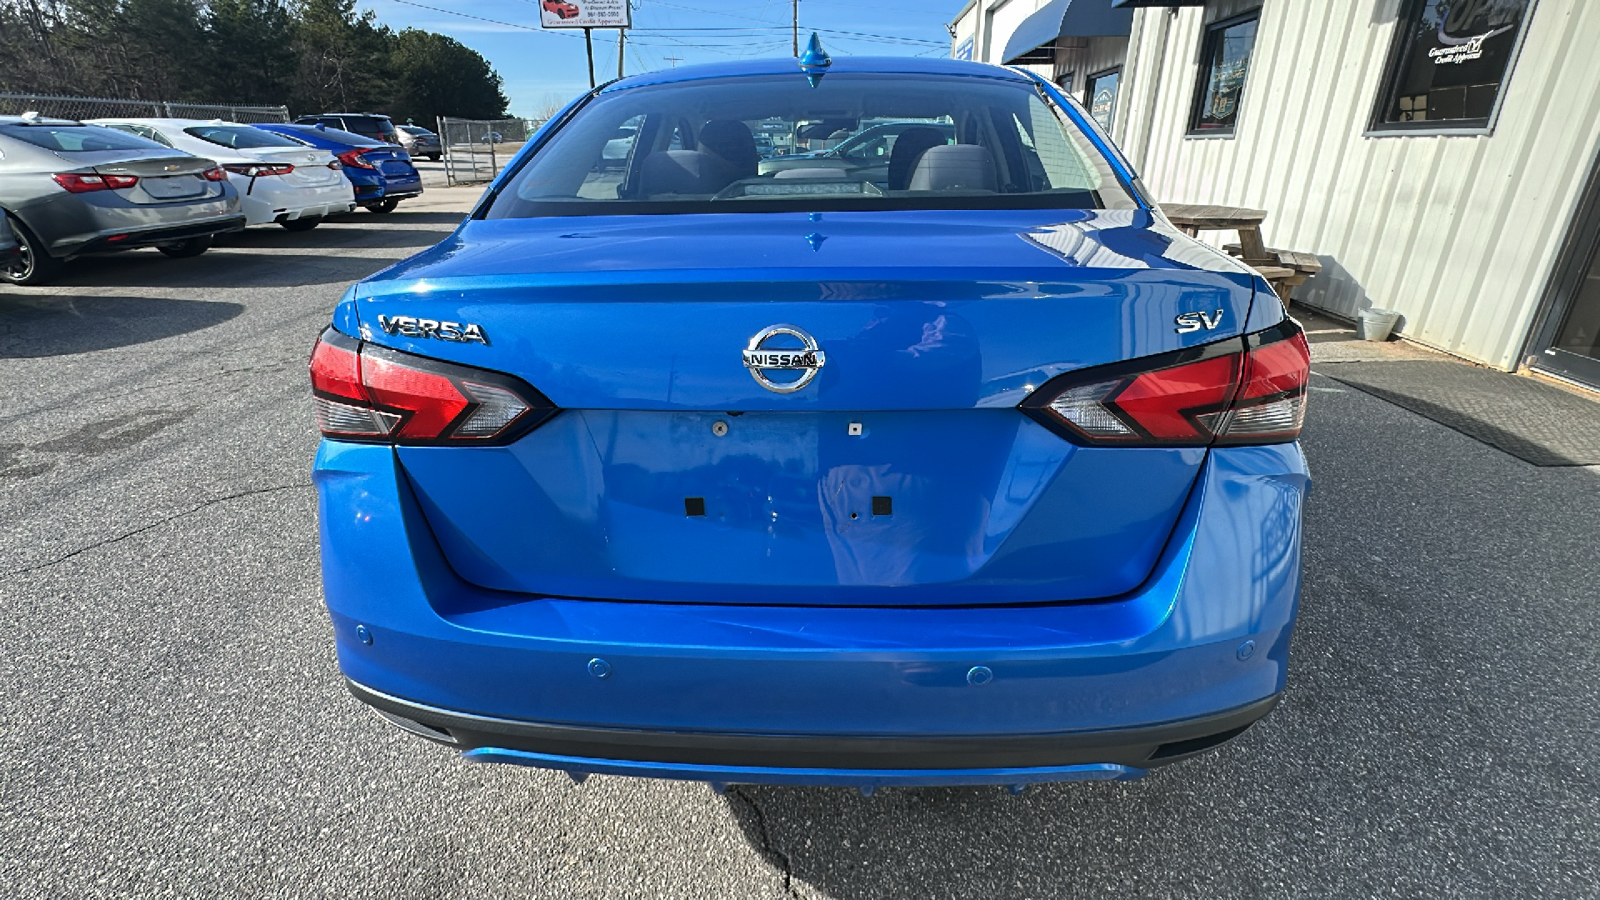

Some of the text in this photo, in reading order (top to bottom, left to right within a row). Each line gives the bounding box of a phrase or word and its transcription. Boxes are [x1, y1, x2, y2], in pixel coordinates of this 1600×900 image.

[378, 314, 493, 347] VERSA
[1174, 309, 1224, 334] SV
[751, 354, 817, 366] NISSAN
